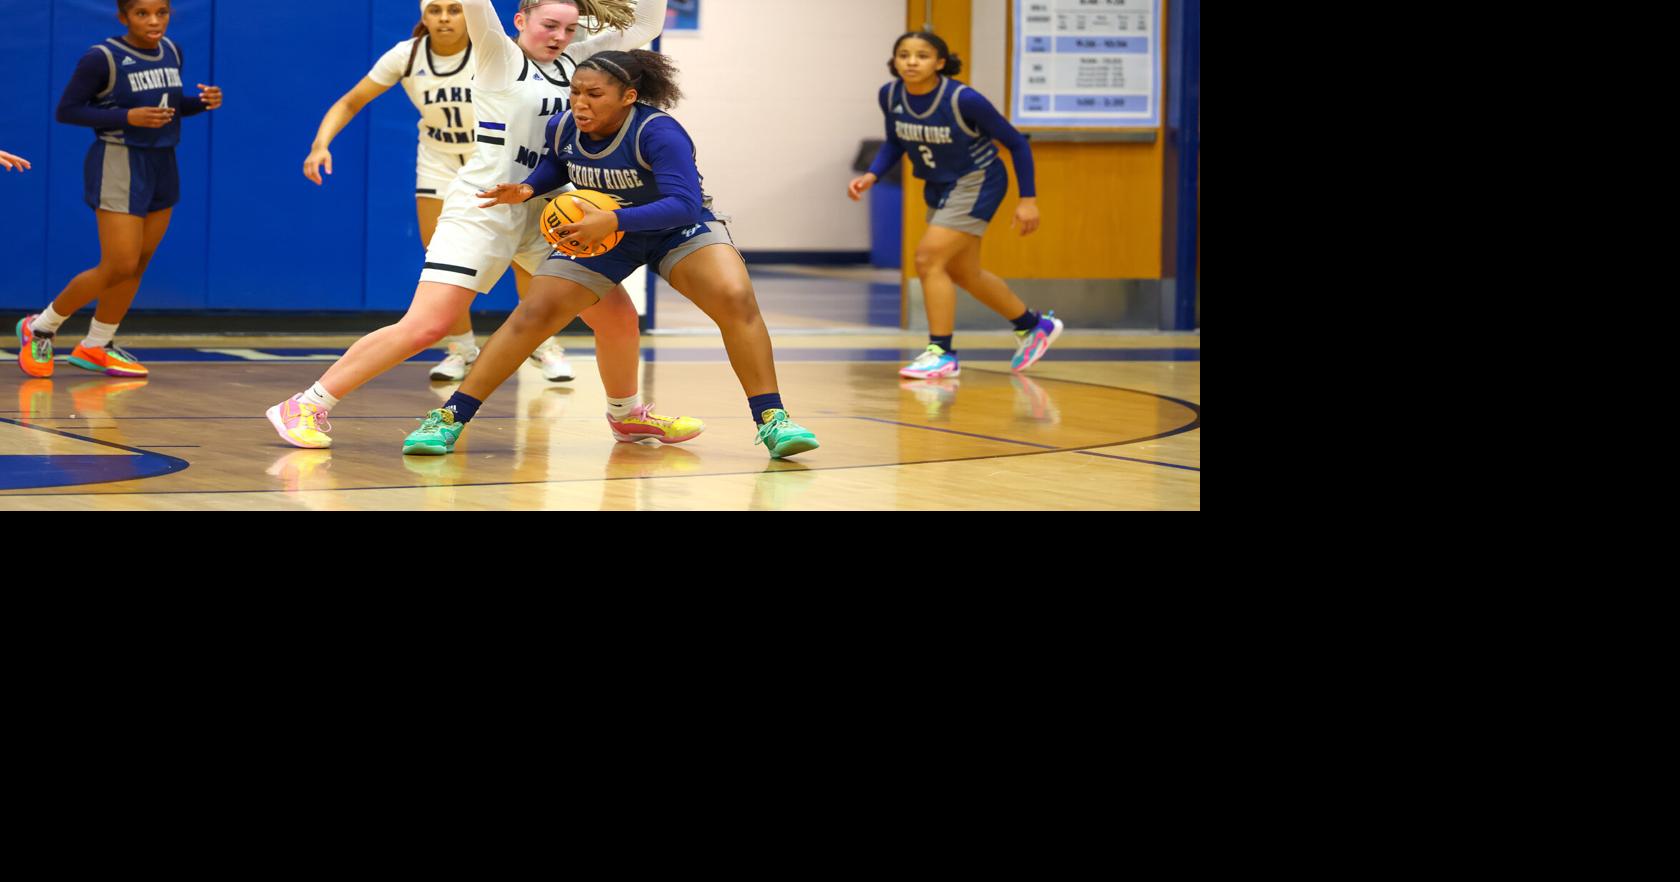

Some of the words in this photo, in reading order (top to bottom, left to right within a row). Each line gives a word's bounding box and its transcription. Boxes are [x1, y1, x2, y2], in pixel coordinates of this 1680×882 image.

[440, 106, 464, 128] 11
[918, 145, 936, 168] 2
[603, 168, 645, 190] RIDGE
